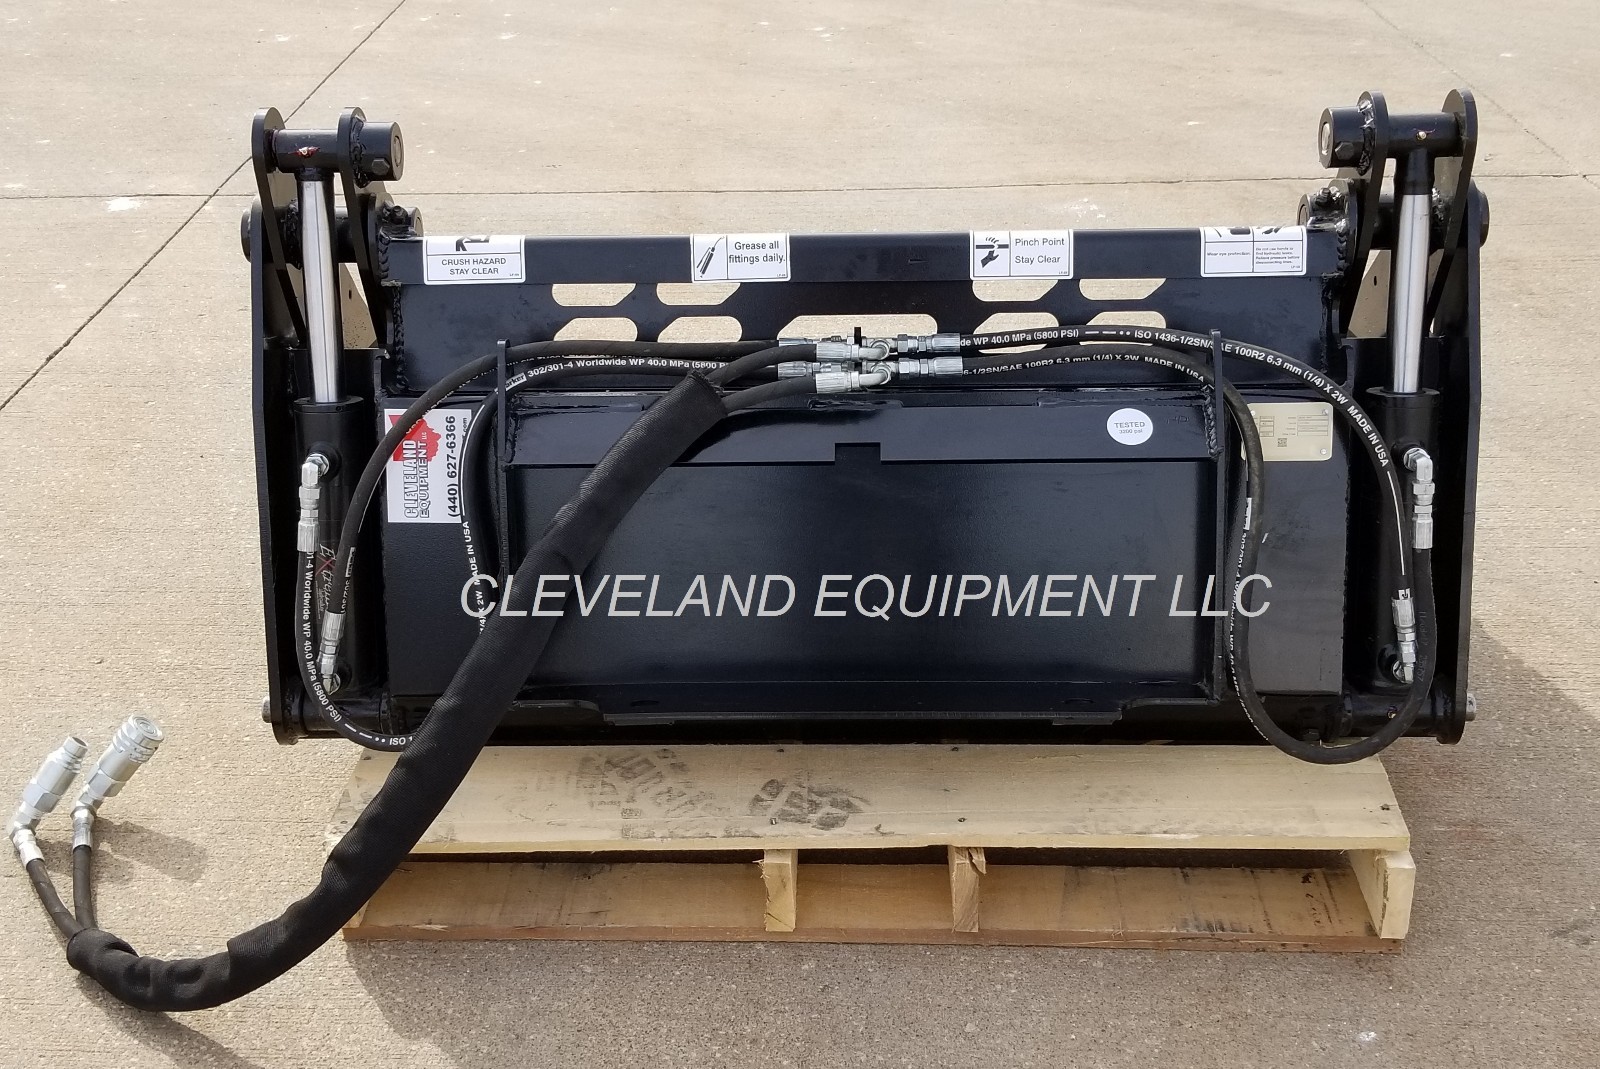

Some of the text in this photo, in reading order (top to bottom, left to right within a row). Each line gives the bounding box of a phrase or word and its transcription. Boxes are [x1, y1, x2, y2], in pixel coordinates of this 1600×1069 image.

[734, 240, 779, 250] Grease all
[1015, 238, 1065, 246] Pinch Point
[729, 253, 786, 264] fittings daily.
[1014, 255, 1060, 265] Stay Clear
[527, 361, 574, 378] 302/301-4
[576, 358, 626, 368] Worldwide
[629, 358, 645, 367] WP
[647, 359, 667, 367] 40,0
[669, 359, 690, 368] MPa
[691, 360, 717, 369] (5800
[1145, 356, 1173, 368] MADE
[973, 336, 990, 346] WP
[991, 334, 1010, 345] 40,0
[1012, 332, 1031, 342] MPa
[1033, 330, 1058, 340] (5800
[1060, 329, 1079, 338] PSI)
[1134, 330, 1151, 339] ISO
[1234, 346, 1265, 361] 100R2
[1266, 355, 1283, 366] 6,3
[1282, 361, 1302, 376] mm
[1303, 370, 1326, 388] (1/4)
[1323, 383, 1333, 394] X
[1330, 390, 1349, 406] 2W
[1346, 404, 1370, 434] MADE
[1368, 431, 1379, 446] IN
[1374, 444, 1388, 468] USA
[445, 415, 460, 517] (440) 627-6366
[402, 440, 419, 518] CLEVELAND
[418, 440, 431, 518] EQUIPMENT
[462, 521, 472, 543] USA
[467, 544, 475, 554] IN
[470, 558, 480, 586] MADE
[302, 570, 313, 620] Worldwide
[476, 590, 484, 606] 2W
[302, 622, 312, 638] WP
[304, 639, 313, 658] 40,0
[306, 659, 316, 681] MPa
[312, 681, 329, 705] (5800
[326, 704, 342, 723] PSI)
[389, 736, 406, 746] ISO
